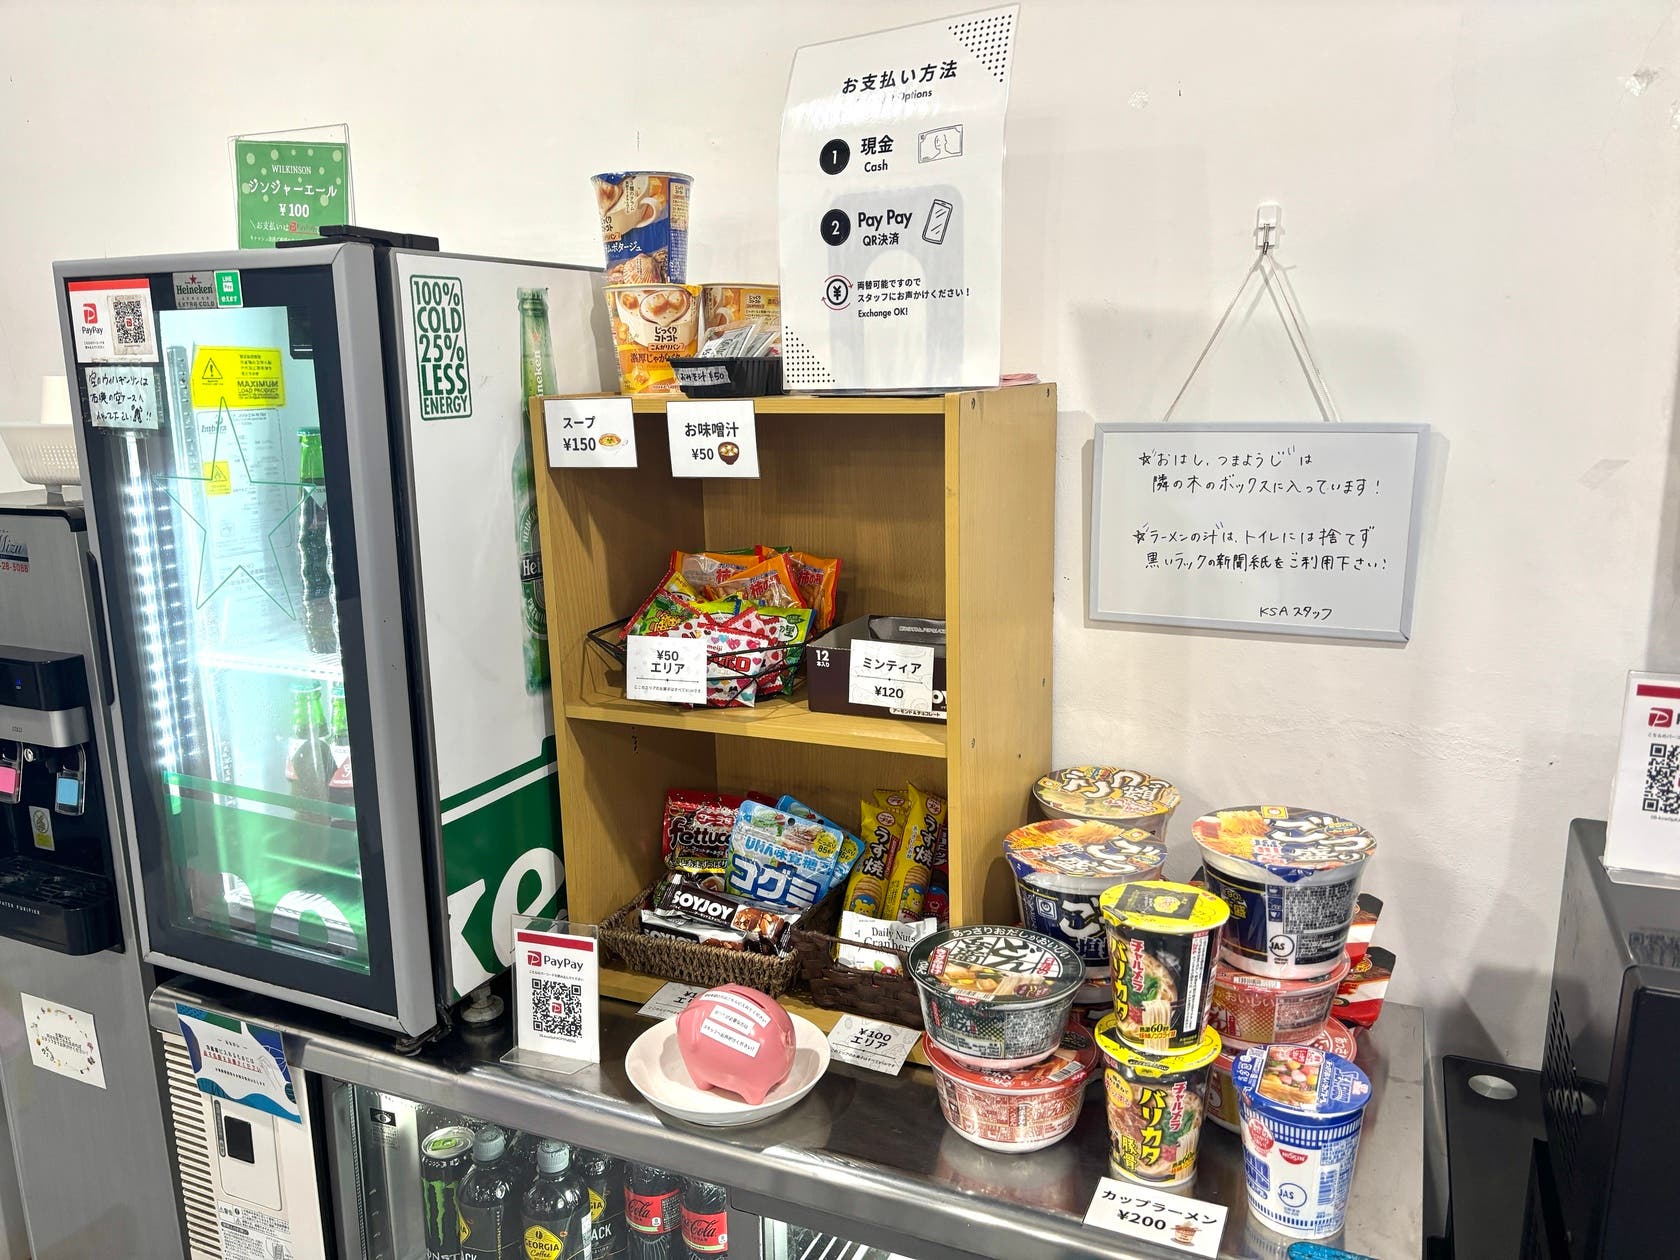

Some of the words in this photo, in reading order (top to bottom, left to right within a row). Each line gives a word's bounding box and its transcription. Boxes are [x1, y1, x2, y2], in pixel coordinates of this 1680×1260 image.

[842, 59, 957, 94] お支払い方法
[860, 134, 894, 156] 現金
[271, 164, 312, 175] WILKINSON
[864, 159, 888, 173] Cash
[248, 178, 337, 198] ジンジャーエール
[279, 203, 310, 218] ¥100
[858, 211, 883, 232] Pay
[886, 209, 912, 229] Pay
[862, 232, 900, 247] QR決済
[176, 285, 213, 295] Heineken
[857, 278, 922, 291] 両替可能ですので
[414, 281, 460, 306] 100%
[417, 306, 462, 333] COLD
[857, 309, 892, 318] Exchange
[893, 307, 908, 317] OK!
[81, 326, 104, 336] PayPay
[654, 334, 678, 342] コトコト
[419, 334, 465, 363] 25%
[421, 363, 468, 396] LESS
[424, 395, 468, 415] ENERGY
[563, 416, 596, 429] スープ
[684, 422, 740, 439] お味噌汁
[563, 437, 597, 452] ¥150
[691, 448, 715, 461] ¥50
[1259, 606, 1288, 618] KSA
[1293, 607, 1333, 619] スタッフ
[656, 650, 679, 661] ¥50
[815, 650, 829, 661] 12
[651, 662, 685, 675] エリア
[863, 657, 922, 674] ミンティア
[874, 685, 904, 699] ¥120
[913, 813, 938, 868] うす焼
[864, 826, 891, 880] うす焼
[729, 855, 820, 907] コグミ
[672, 890, 734, 920] SOYJOY
[872, 926, 894, 940] Daily
[896, 930, 917, 943] Nuts
[1269, 937, 1285, 951] JAS
[543, 954, 584, 972] PayPay
[1130, 938, 1145, 993] チャルメラ
[850, 1035, 888, 1050] エリア
[858, 1027, 892, 1042] ¥100
[1169, 1081, 1188, 1133] チャルメラ
[1138, 1086, 1168, 1168] バリカタ
[1121, 1134, 1139, 1171] 豚骨
[1278, 1187, 1296, 1201] JAS
[628, 1199, 653, 1218] Cola
[1101, 1190, 1217, 1225] カップラーメン
[1118, 1209, 1166, 1230] ¥200
[690, 1219, 719, 1238] Cola
